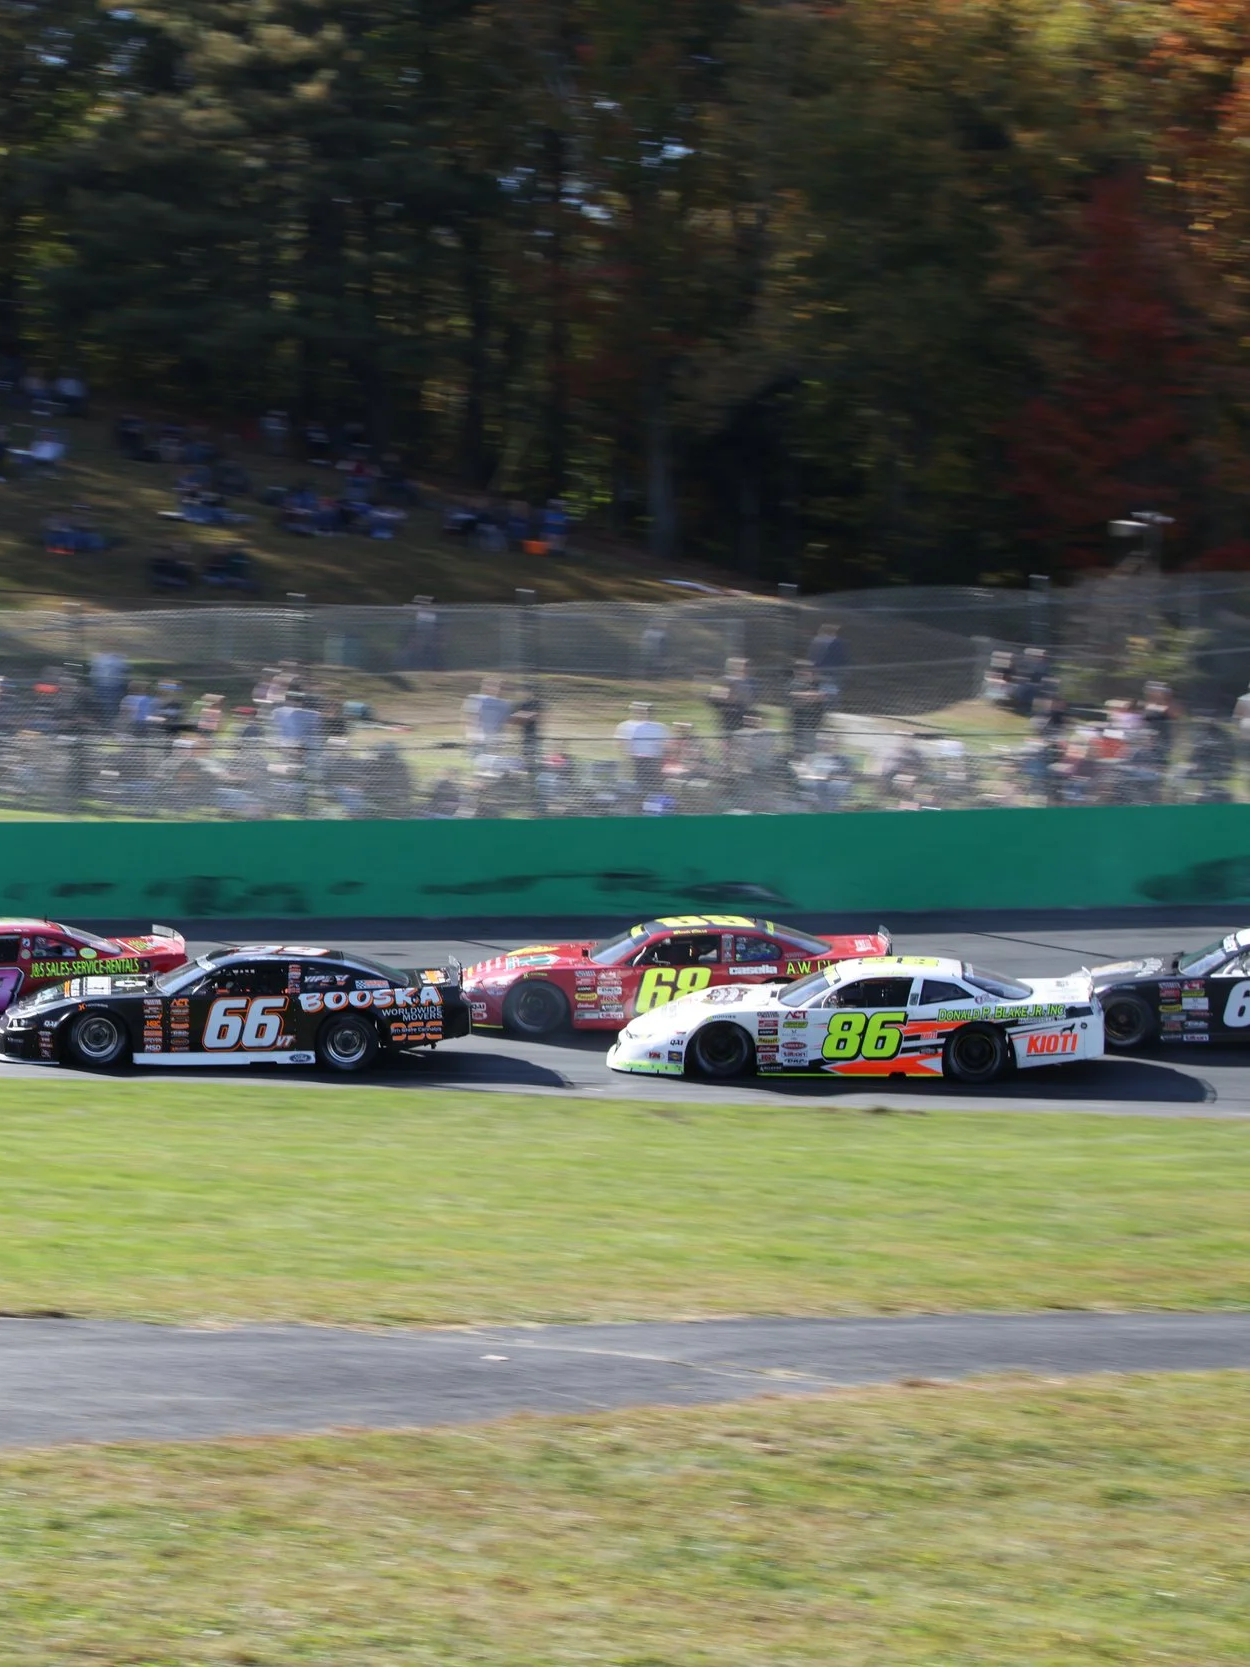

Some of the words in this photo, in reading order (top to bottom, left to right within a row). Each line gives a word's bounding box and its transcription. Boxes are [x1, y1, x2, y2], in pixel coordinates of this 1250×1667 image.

[729, 965, 778, 975] casella
[635, 967, 712, 1013] 68
[298, 986, 444, 1013] BOOSKA
[382, 1006, 443, 1016] WORLDWIDE
[402, 1012, 443, 1021] MOVERS
[785, 1010, 808, 1019] ACT
[938, 1008, 980, 1021] DONALD
[994, 1006, 1029, 1019] BLAKE
[202, 996, 290, 1052] 66
[821, 1011, 909, 1062] 86
[1027, 1034, 1078, 1054] KIOTI
